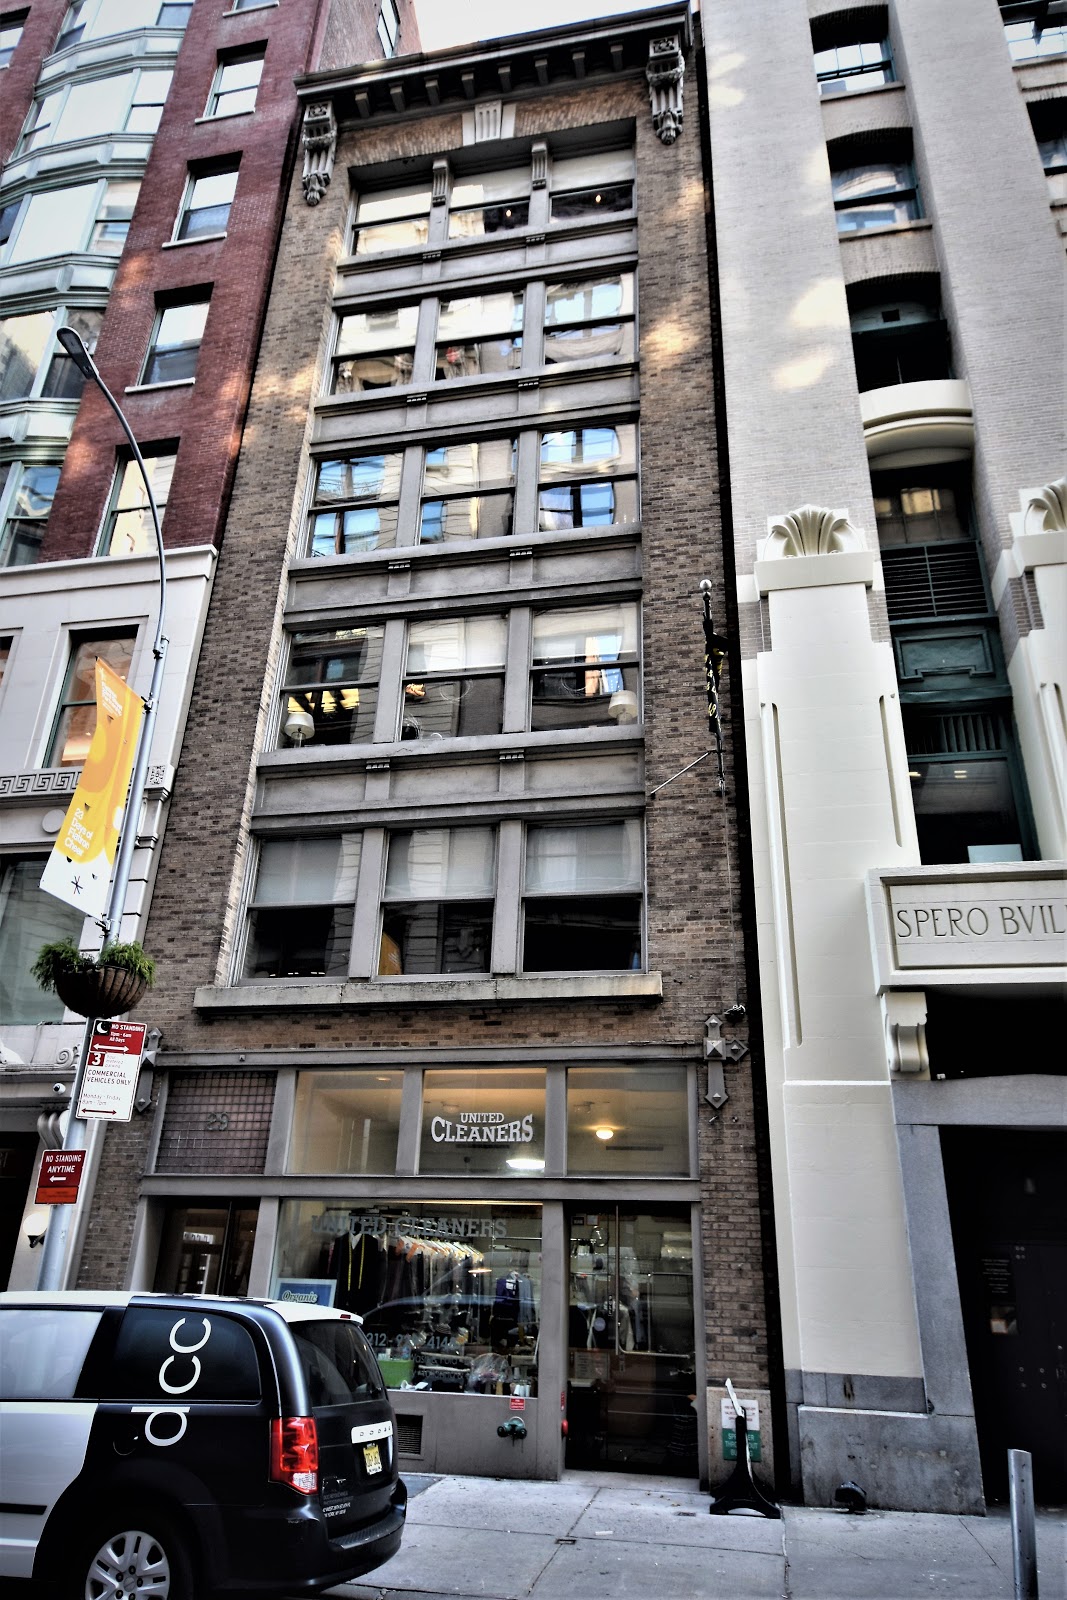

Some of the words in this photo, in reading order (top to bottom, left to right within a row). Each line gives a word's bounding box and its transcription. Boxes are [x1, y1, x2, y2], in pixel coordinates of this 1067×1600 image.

[897, 907, 989, 938] SPERO
[999, 904, 1067, 936] BVIL
[120, 1024, 144, 1032] STANDING
[91, 1053, 102, 1066] 3
[88, 1069, 127, 1079] COMMERCIAL
[87, 1076, 115, 1085] VEHICLES
[460, 1112, 505, 1124] UNITED
[430, 1113, 534, 1143] CLEANERS
[45, 1155, 54, 1163] NO
[55, 1154, 82, 1163] STANDING
[47, 1165, 76, 1174] ANYTIME
[311, 1214, 387, 1236] UNITED
[393, 1215, 507, 1239] CLEANERS
[281, 1289, 318, 1304] Organic
[131, 1317, 212, 1447] dcc
